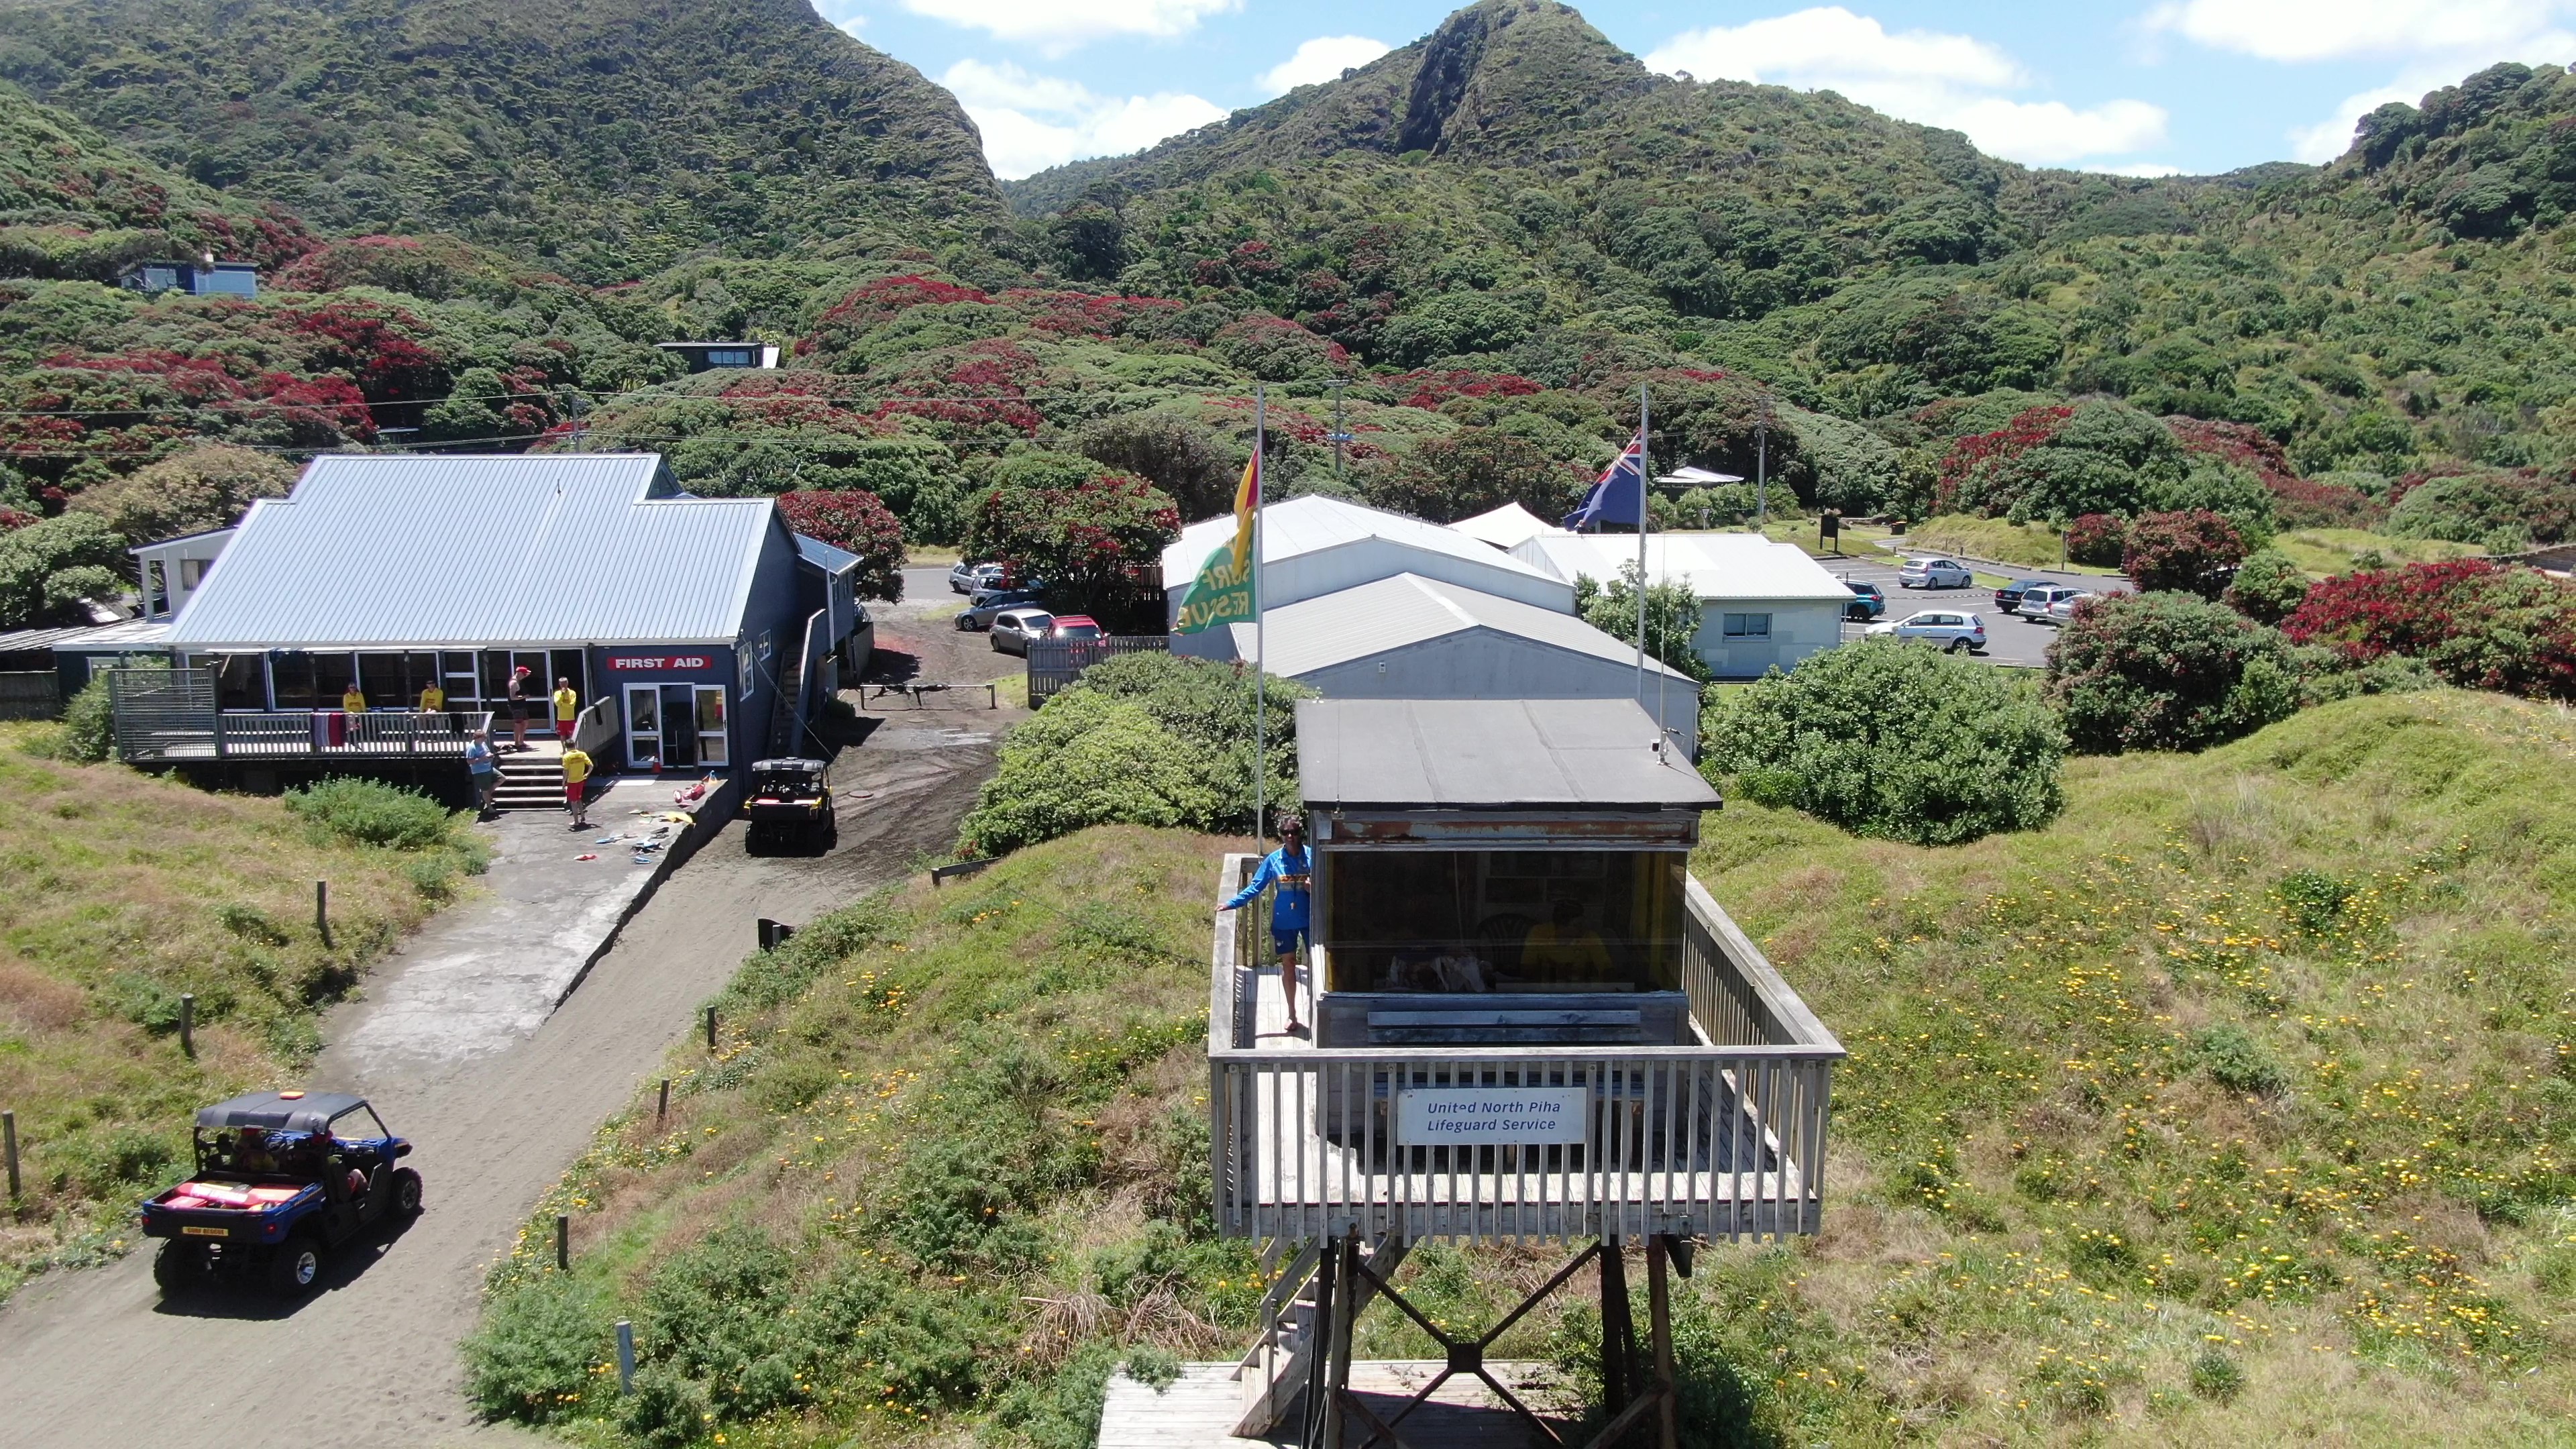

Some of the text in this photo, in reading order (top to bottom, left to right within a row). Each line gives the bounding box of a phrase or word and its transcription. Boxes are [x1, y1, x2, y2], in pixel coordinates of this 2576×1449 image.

[615, 657, 704, 668] FIRST AID
[1428, 1101, 1561, 1114] United North Piha
[1428, 1119, 1556, 1134] Lifeguard Service
